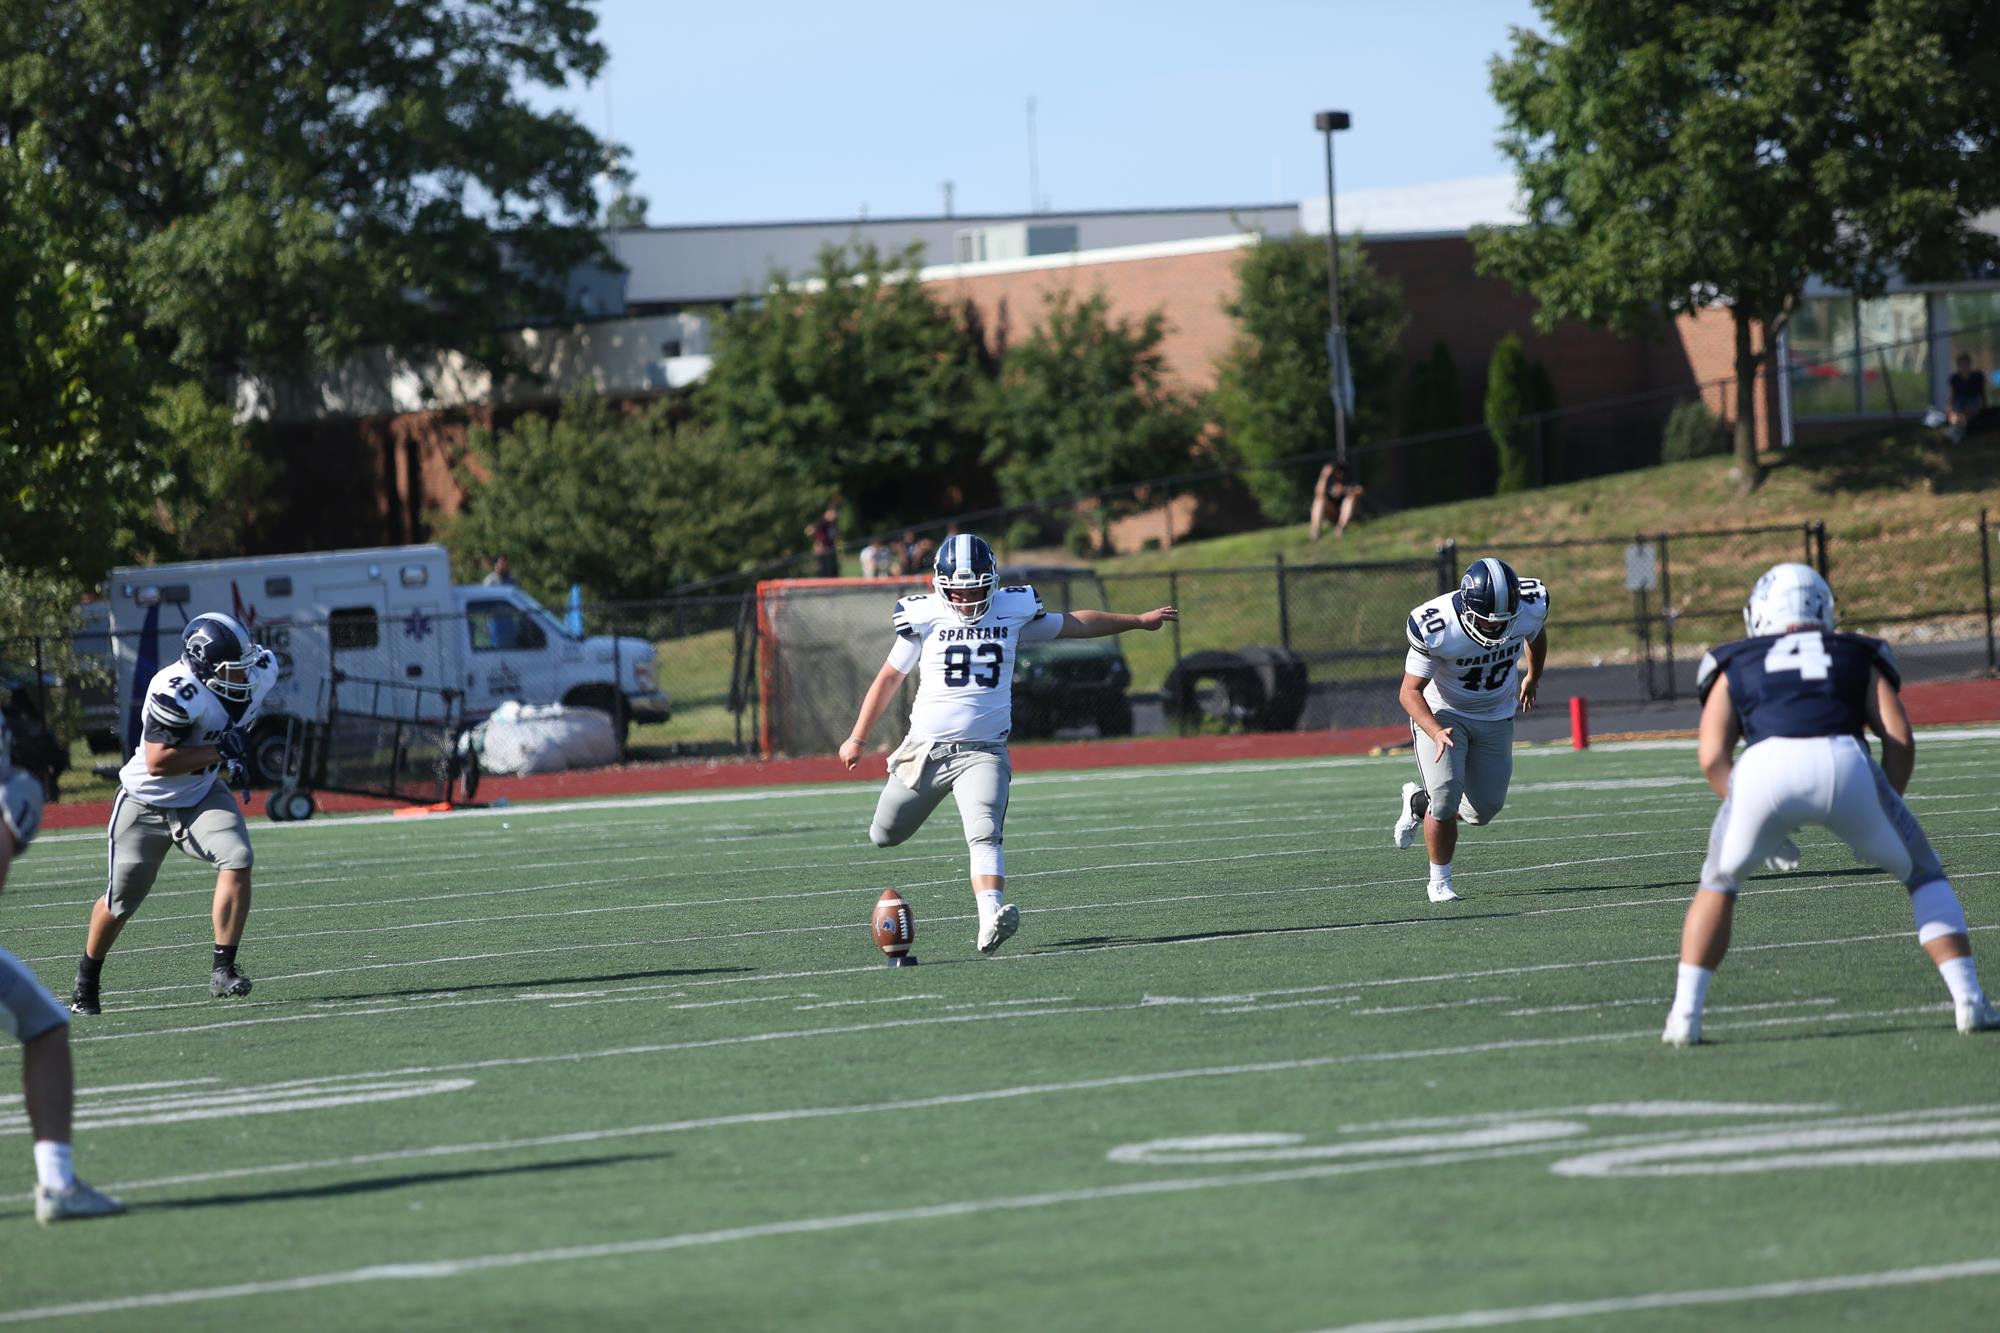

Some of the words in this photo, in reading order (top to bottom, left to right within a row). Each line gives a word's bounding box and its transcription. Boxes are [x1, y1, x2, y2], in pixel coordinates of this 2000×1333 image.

[938, 625, 1009, 642] SPARTANS
[1421, 607, 1446, 634] 40
[944, 643, 1004, 689] 83
[1456, 642, 1521, 666] SPARTANS
[1764, 631, 1833, 681] 4
[168, 676, 199, 701] 46
[1458, 658, 1514, 692] 40
